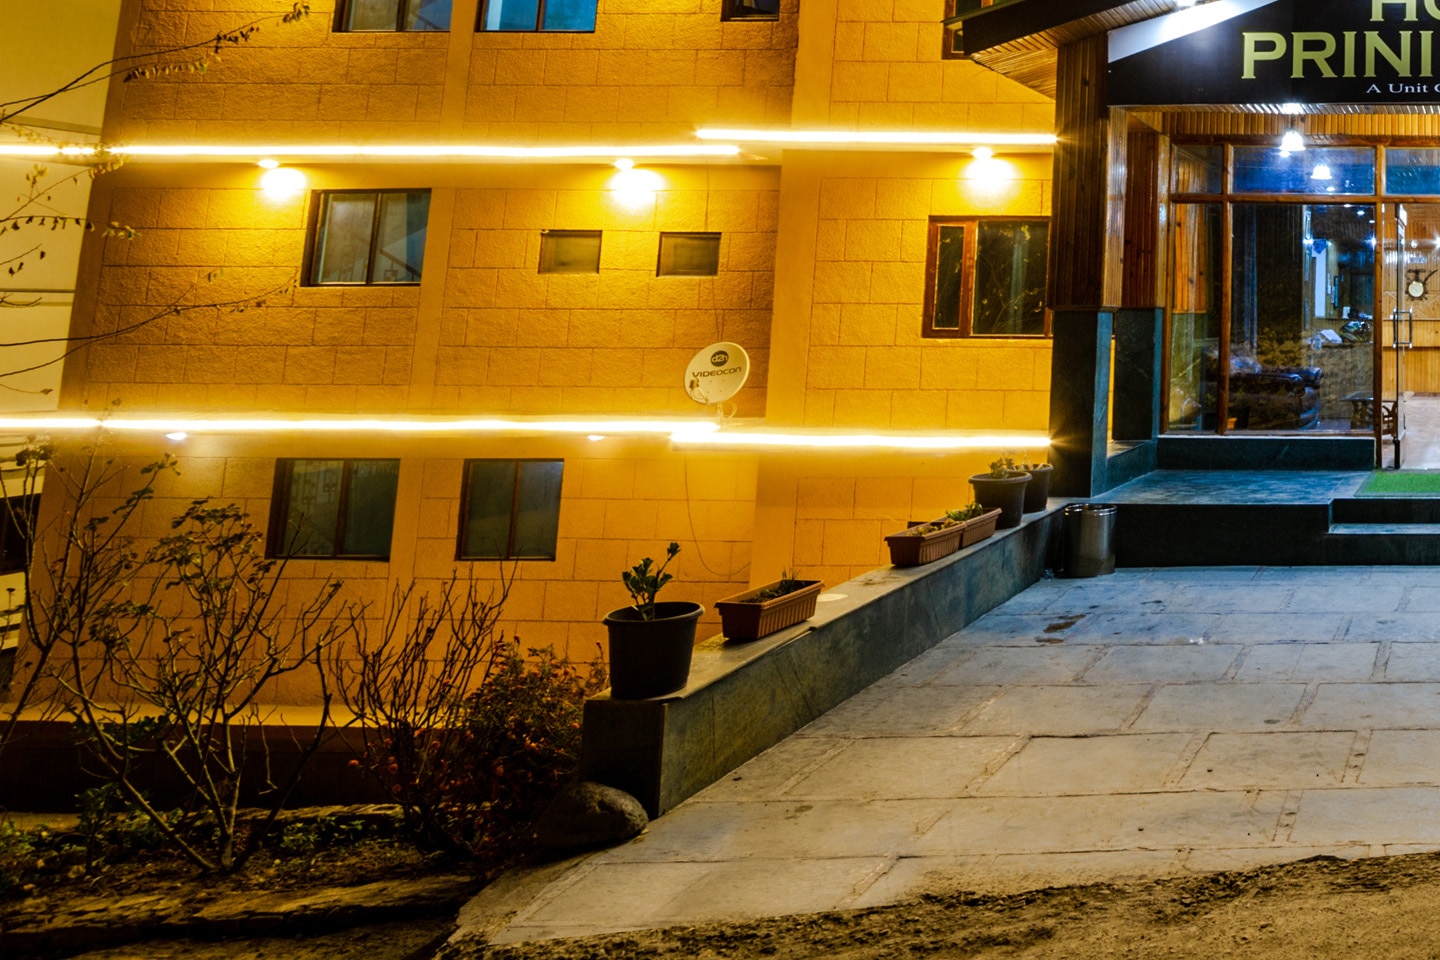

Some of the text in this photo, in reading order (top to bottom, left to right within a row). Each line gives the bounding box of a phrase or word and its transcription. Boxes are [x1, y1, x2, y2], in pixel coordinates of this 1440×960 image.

[1241, 30, 1434, 79] PRINI
[1366, 83, 1382, 94] A
[1388, 83, 1429, 94] Unit
